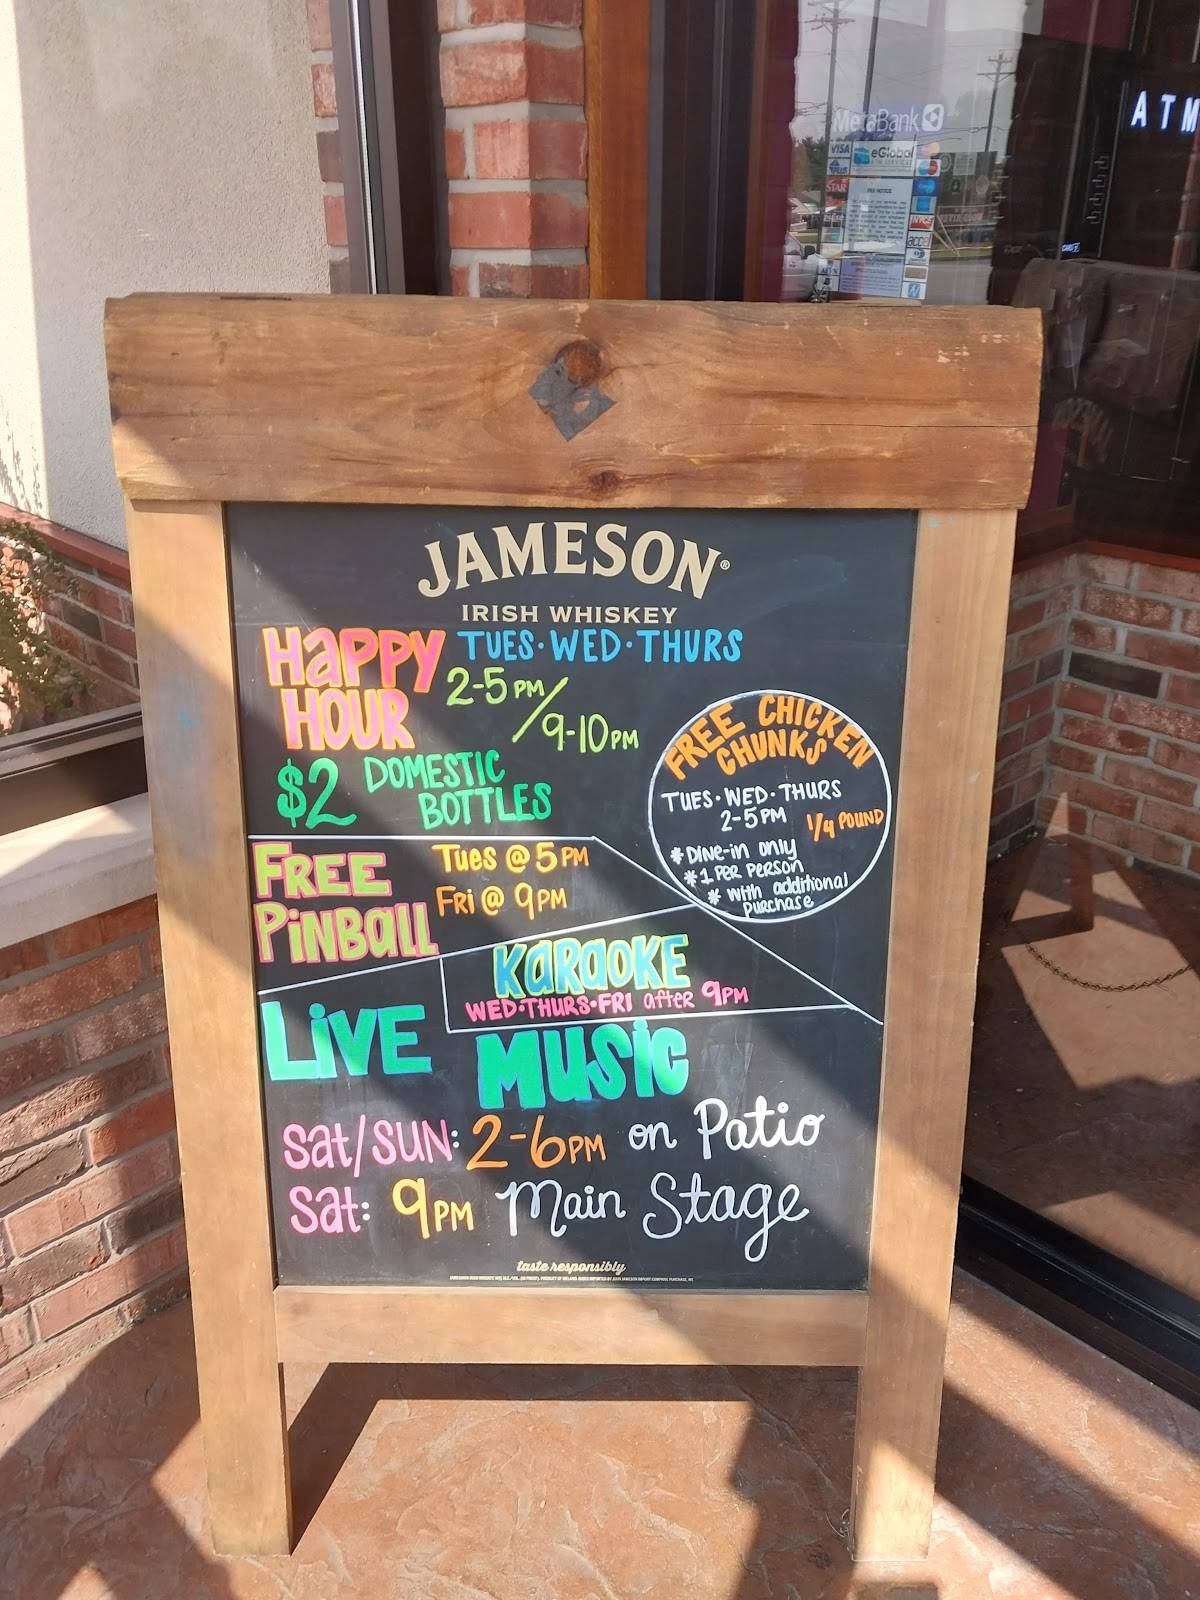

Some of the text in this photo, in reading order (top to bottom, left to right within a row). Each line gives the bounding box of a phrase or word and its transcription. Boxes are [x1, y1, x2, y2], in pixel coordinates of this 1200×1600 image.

[832, 106, 920, 132] MetaBank
[1130, 89, 1200, 133] ATM
[831, 143, 850, 154] VISA
[461, 604, 679, 625] IRISH WHISKEY
[280, 687, 416, 750] HOUR
[664, 694, 875, 781] FREE CHICKEN
[716, 729, 828, 776] CHUNKS
[276, 749, 506, 829] $2 DOMESTIC
[417, 782, 552, 830] BOTTLES
[805, 808, 885, 843] 1/4 POUND
[431, 843, 498, 874] Tues
[505, 844, 531, 874] @
[758, 838, 798, 861] only
[252, 841, 393, 899] FREE
[726, 883, 763, 902] with
[773, 871, 849, 896] additional
[481, 885, 505, 917] @
[628, 1121, 678, 1151] on
[692, 1095, 826, 1160] Patio
[494, 1178, 627, 1238] Main
[642, 1171, 810, 1263] Stage
[516, 1260, 627, 1276] taste responsibly
